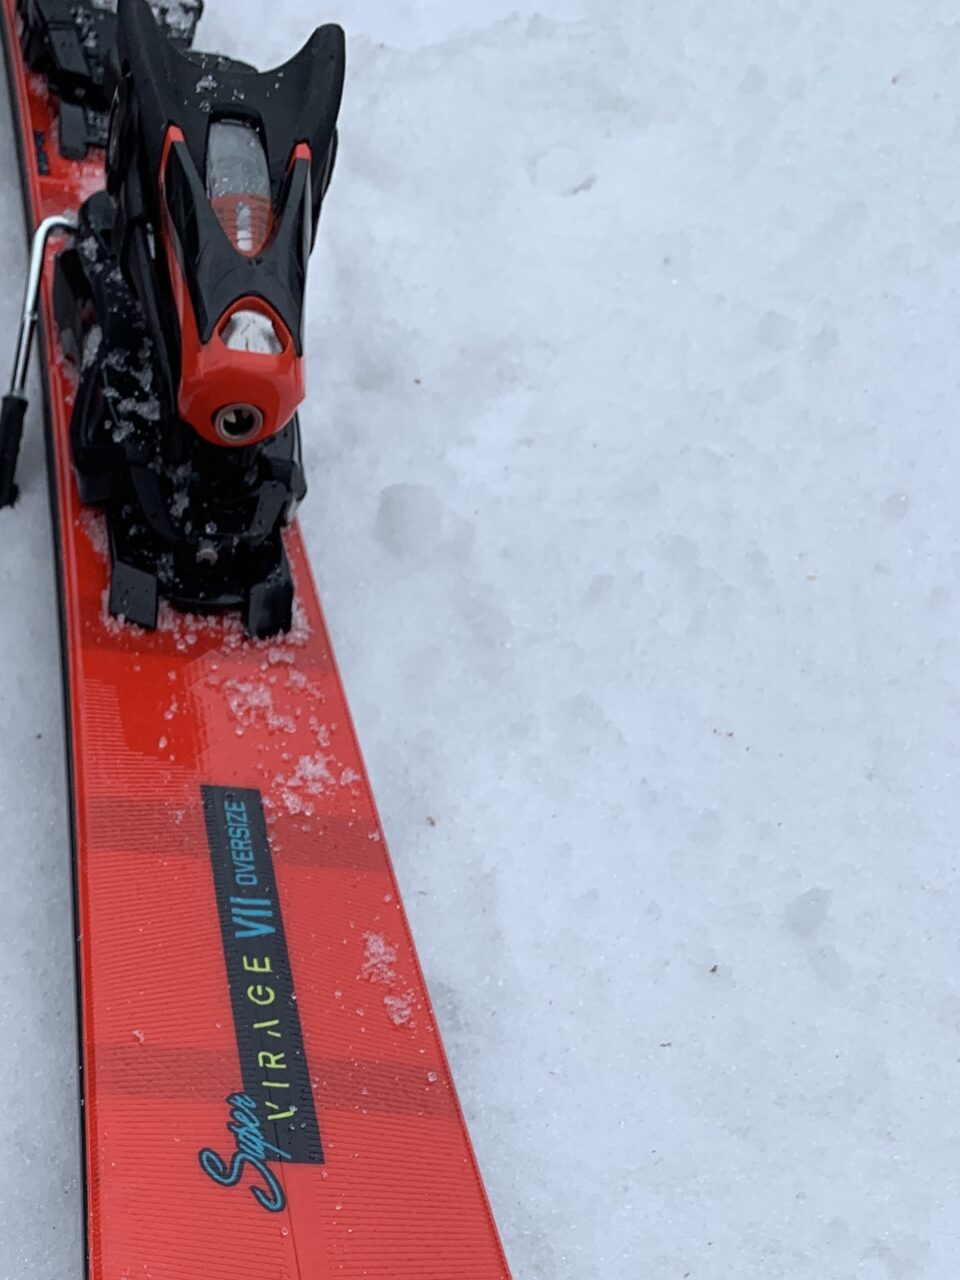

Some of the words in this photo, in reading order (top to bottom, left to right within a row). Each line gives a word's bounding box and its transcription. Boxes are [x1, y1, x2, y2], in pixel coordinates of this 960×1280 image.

[224, 799, 258, 886] OVERSIZE
[229, 895, 277, 939] VII
[242, 955, 295, 1121] VIRAGE
[198, 1092, 292, 1213] Super
